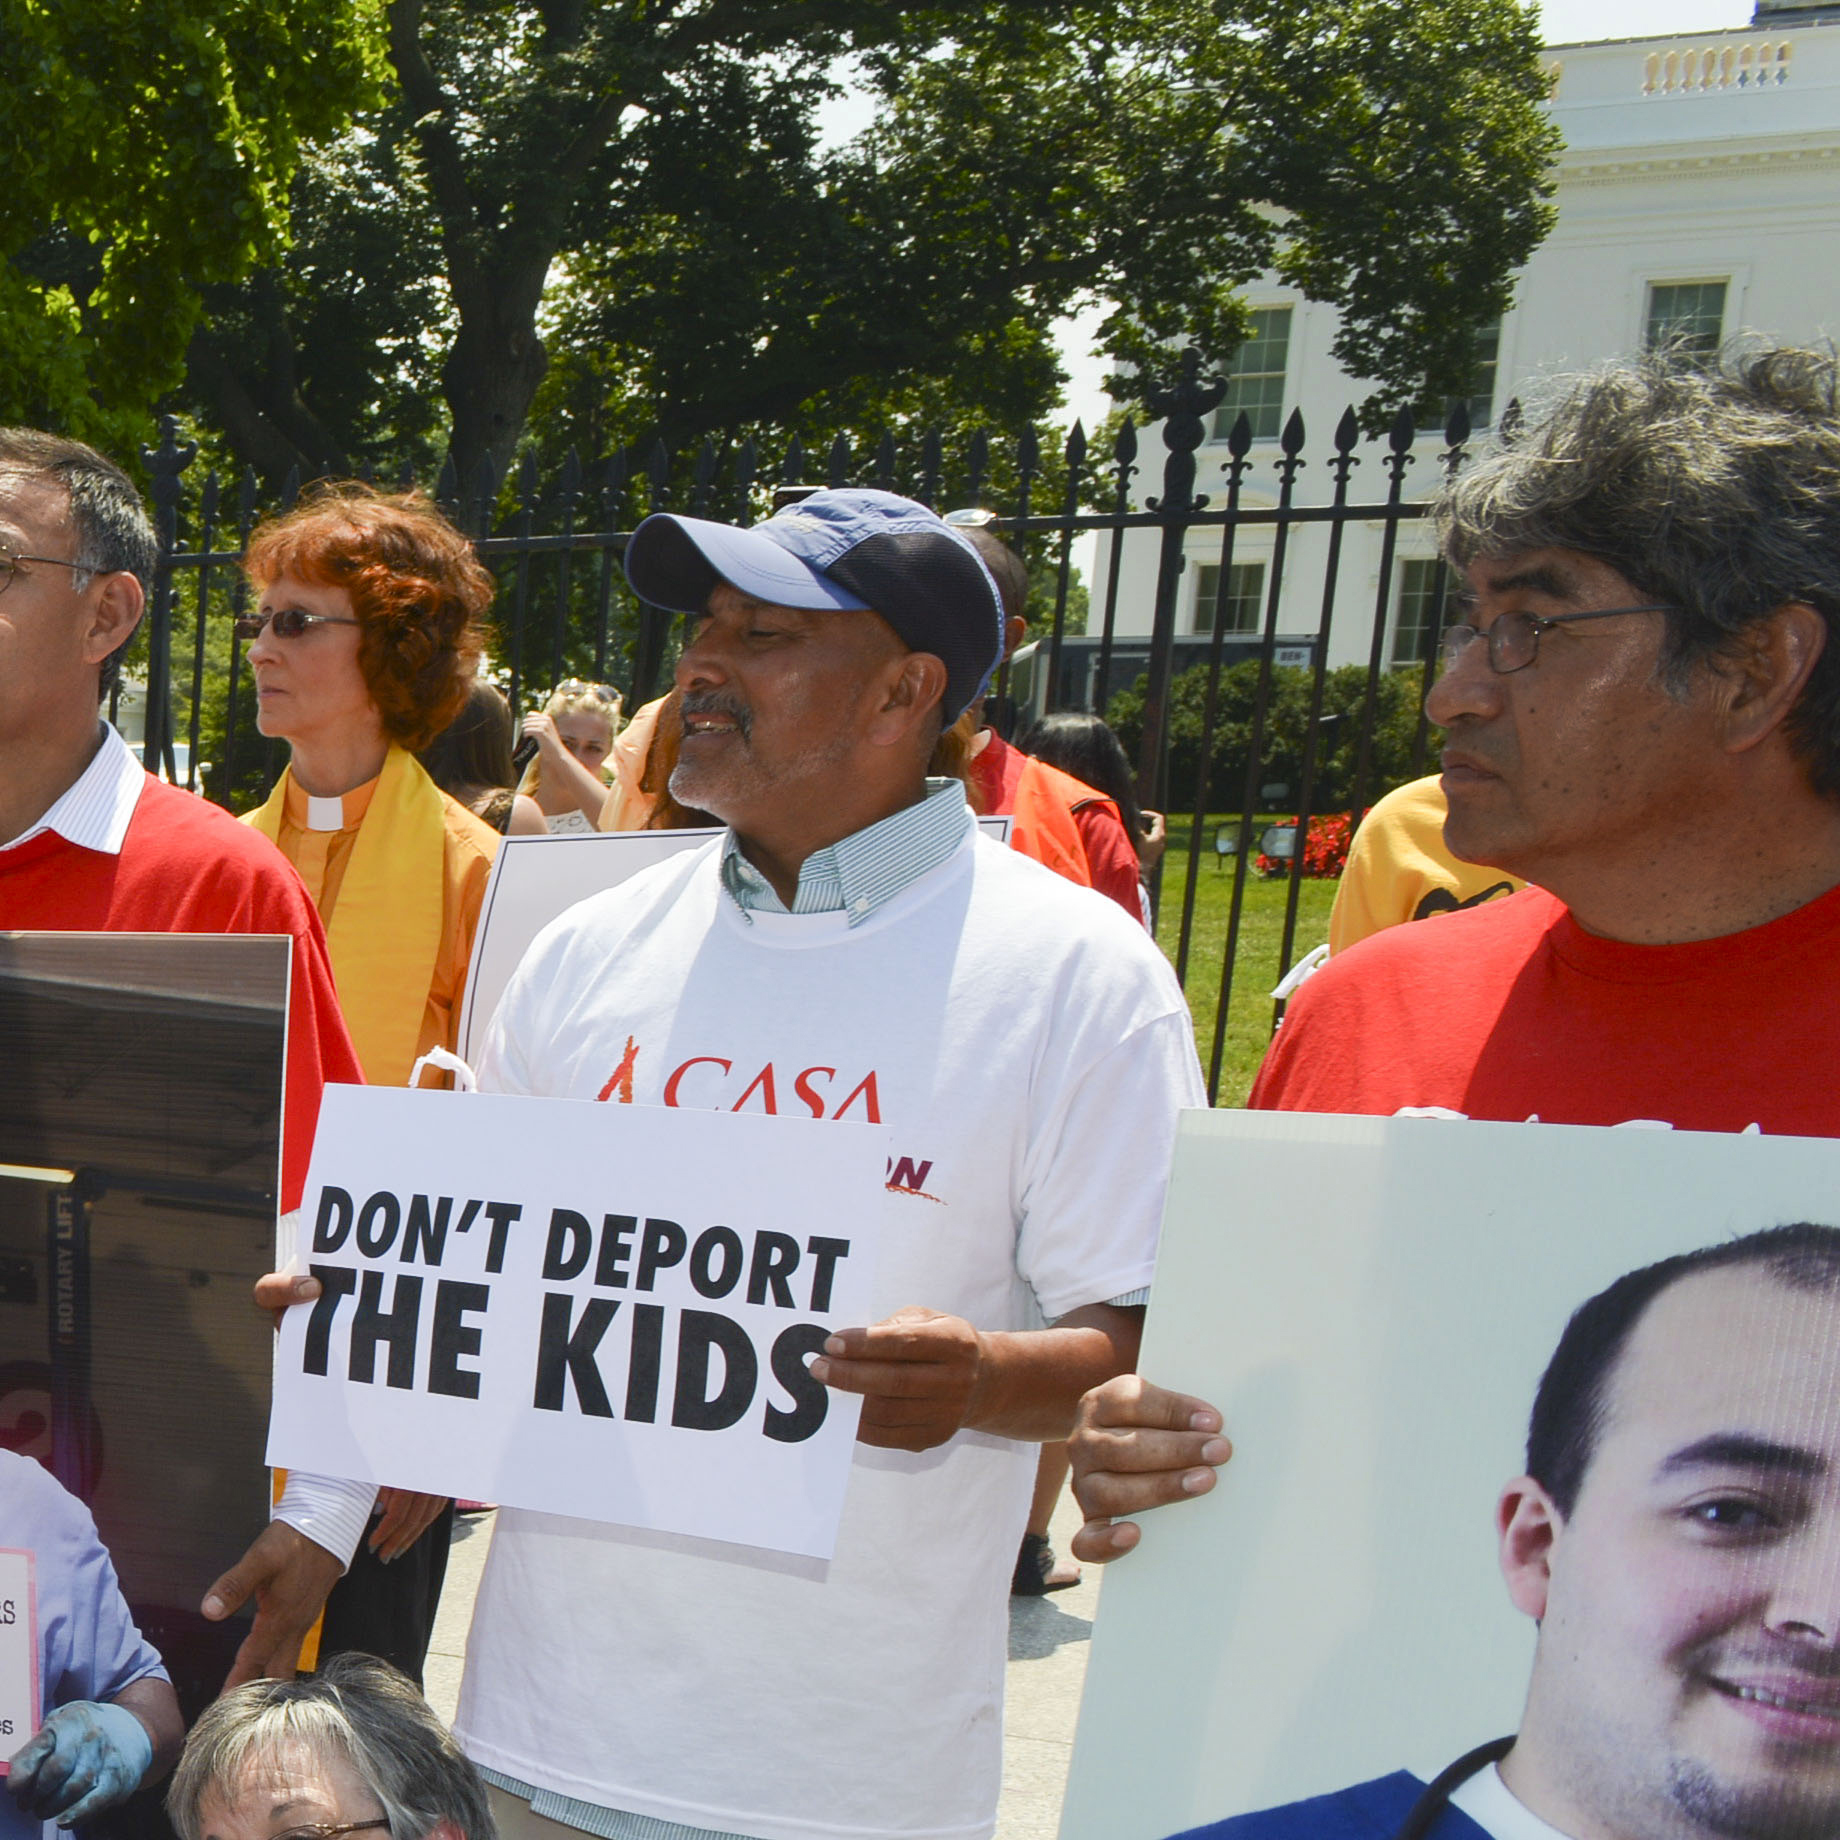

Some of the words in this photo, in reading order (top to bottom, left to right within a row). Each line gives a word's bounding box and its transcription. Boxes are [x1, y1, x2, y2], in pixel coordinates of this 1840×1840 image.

[312, 1185, 523, 1274] DON'T
[542, 1208, 850, 1313] DEPORT
[302, 1264, 490, 1400] THE
[533, 1292, 831, 1444] KIDS
